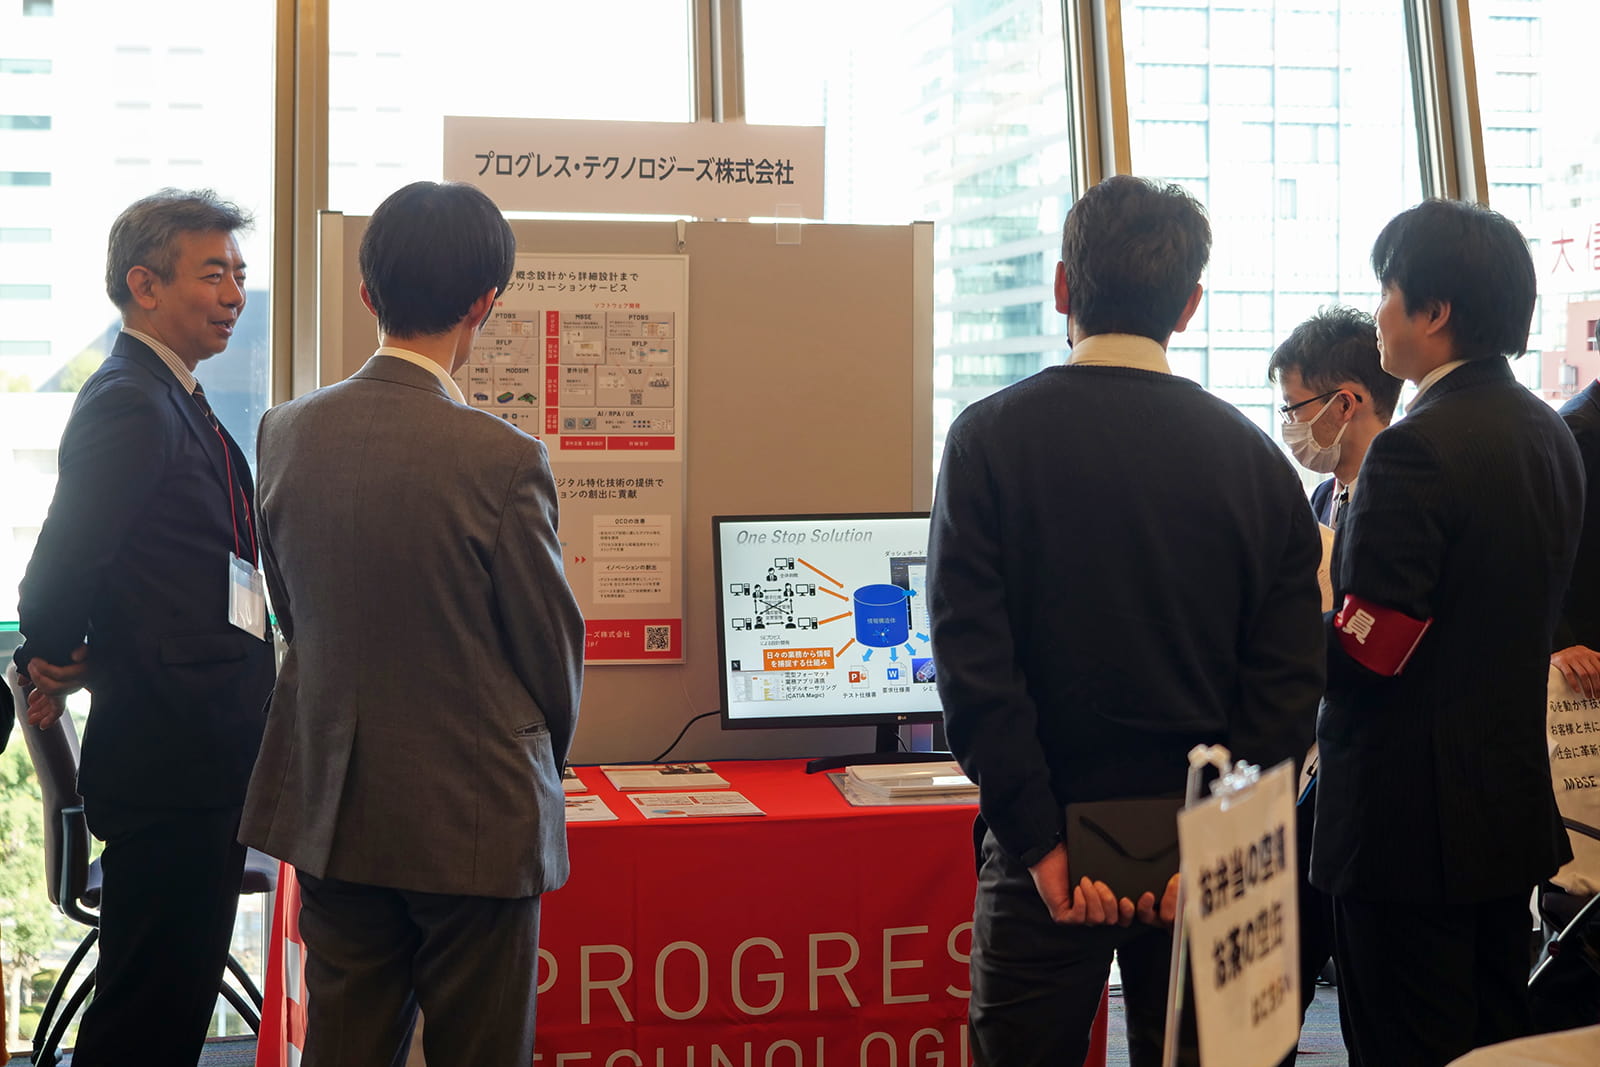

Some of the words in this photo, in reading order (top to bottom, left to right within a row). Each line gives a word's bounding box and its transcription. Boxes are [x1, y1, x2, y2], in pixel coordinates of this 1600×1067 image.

[475, 150, 794, 185] プログレス・テクノロジーズ株式会社
[515, 270, 639, 282] 概念設計から詳細設計まで
[555, 478, 664, 488] ジタル特化技術の提供で
[736, 530, 767, 545] One
[771, 529, 807, 546] Stop
[810, 527, 873, 543] Solution
[767, 650, 831, 659] 日々の業務から情報
[843, 691, 877, 699] テスト仕様書
[1550, 698, 1600, 713] 心を動かす技
[1556, 743, 1600, 760] 社会に革新
[1563, 775, 1598, 791] MBSE
